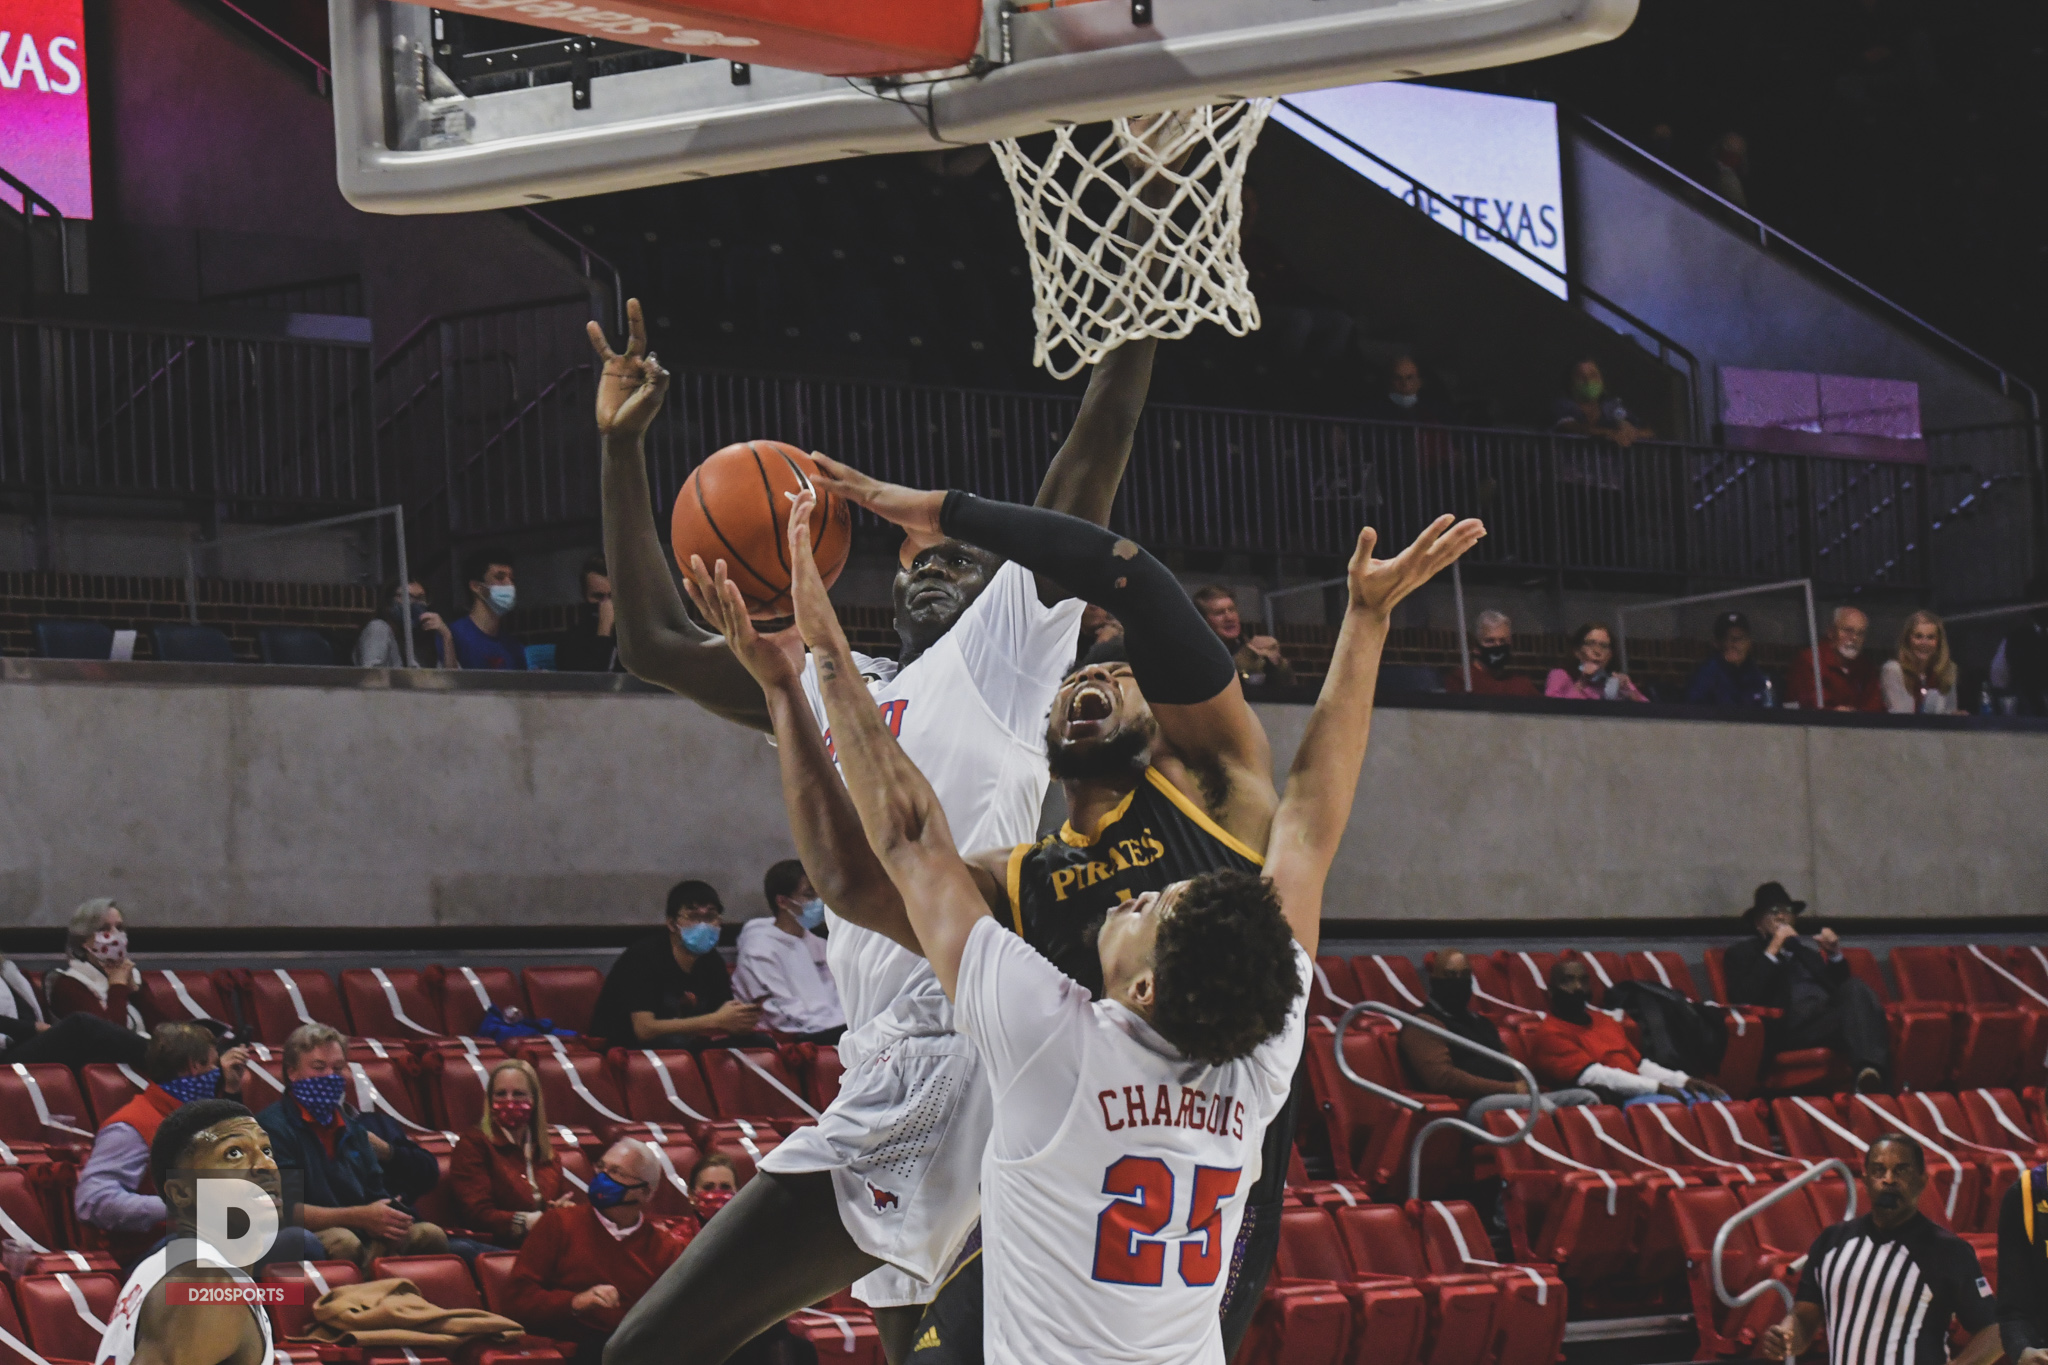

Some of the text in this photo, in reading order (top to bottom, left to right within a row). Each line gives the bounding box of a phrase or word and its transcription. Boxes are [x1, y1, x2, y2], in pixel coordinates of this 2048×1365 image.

[1452, 195, 1558, 249] TEXAS
[1051, 827, 1165, 901] PIRATES
[1098, 1084, 1245, 1141] CHARGOIS
[1091, 1154, 1243, 1288] 25
